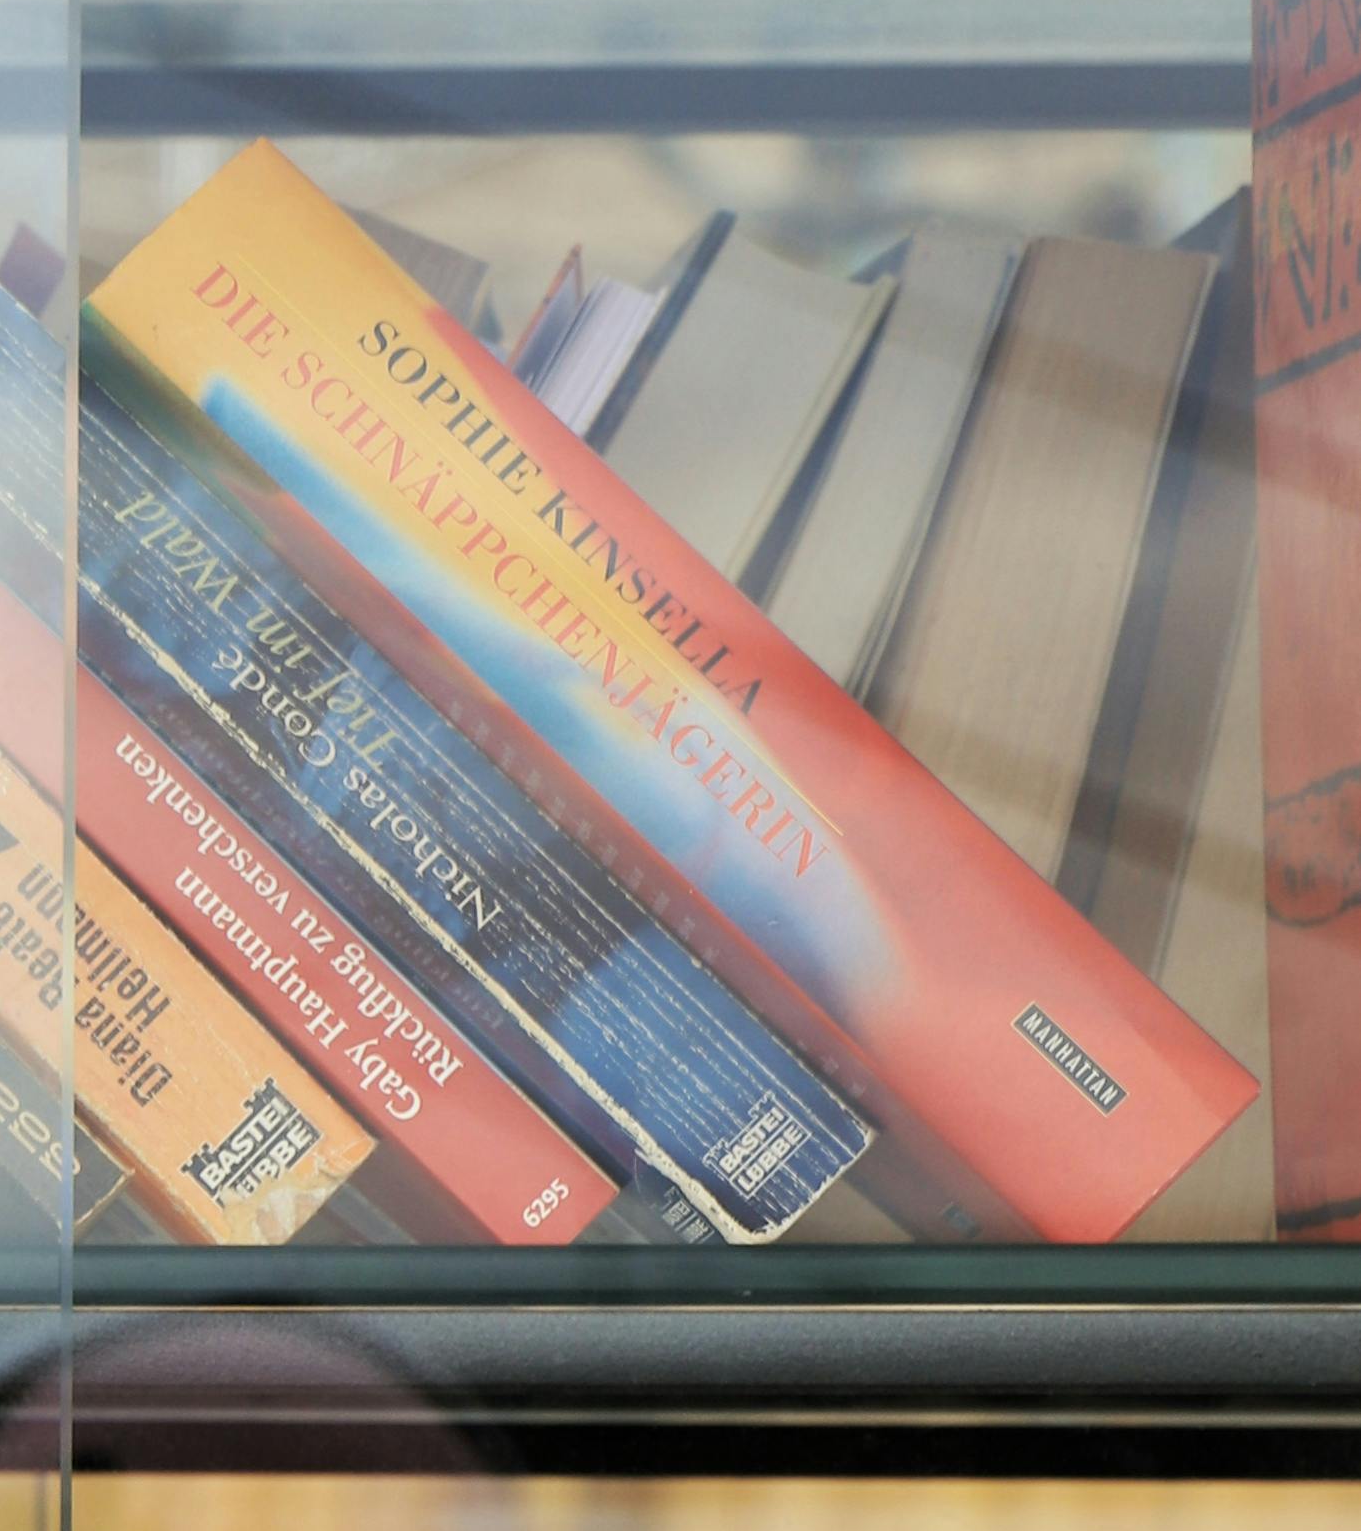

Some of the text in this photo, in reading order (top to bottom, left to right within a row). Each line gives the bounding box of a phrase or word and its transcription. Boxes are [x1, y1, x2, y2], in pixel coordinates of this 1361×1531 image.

[191, 263, 832, 878] DIE SCHNÄPPCHENJÄGERIN
[357, 320, 769, 716] SOPHIE KINSELLA
[115, 733, 465, 1088] Rückflug zu verschenken
[211, 647, 504, 933] Nicholas Condé
[174, 866, 423, 1122] Gaby Hauptmann
[1023, 1007, 1119, 1107] MANHATTAN
[522, 1177, 574, 1231] 6295
